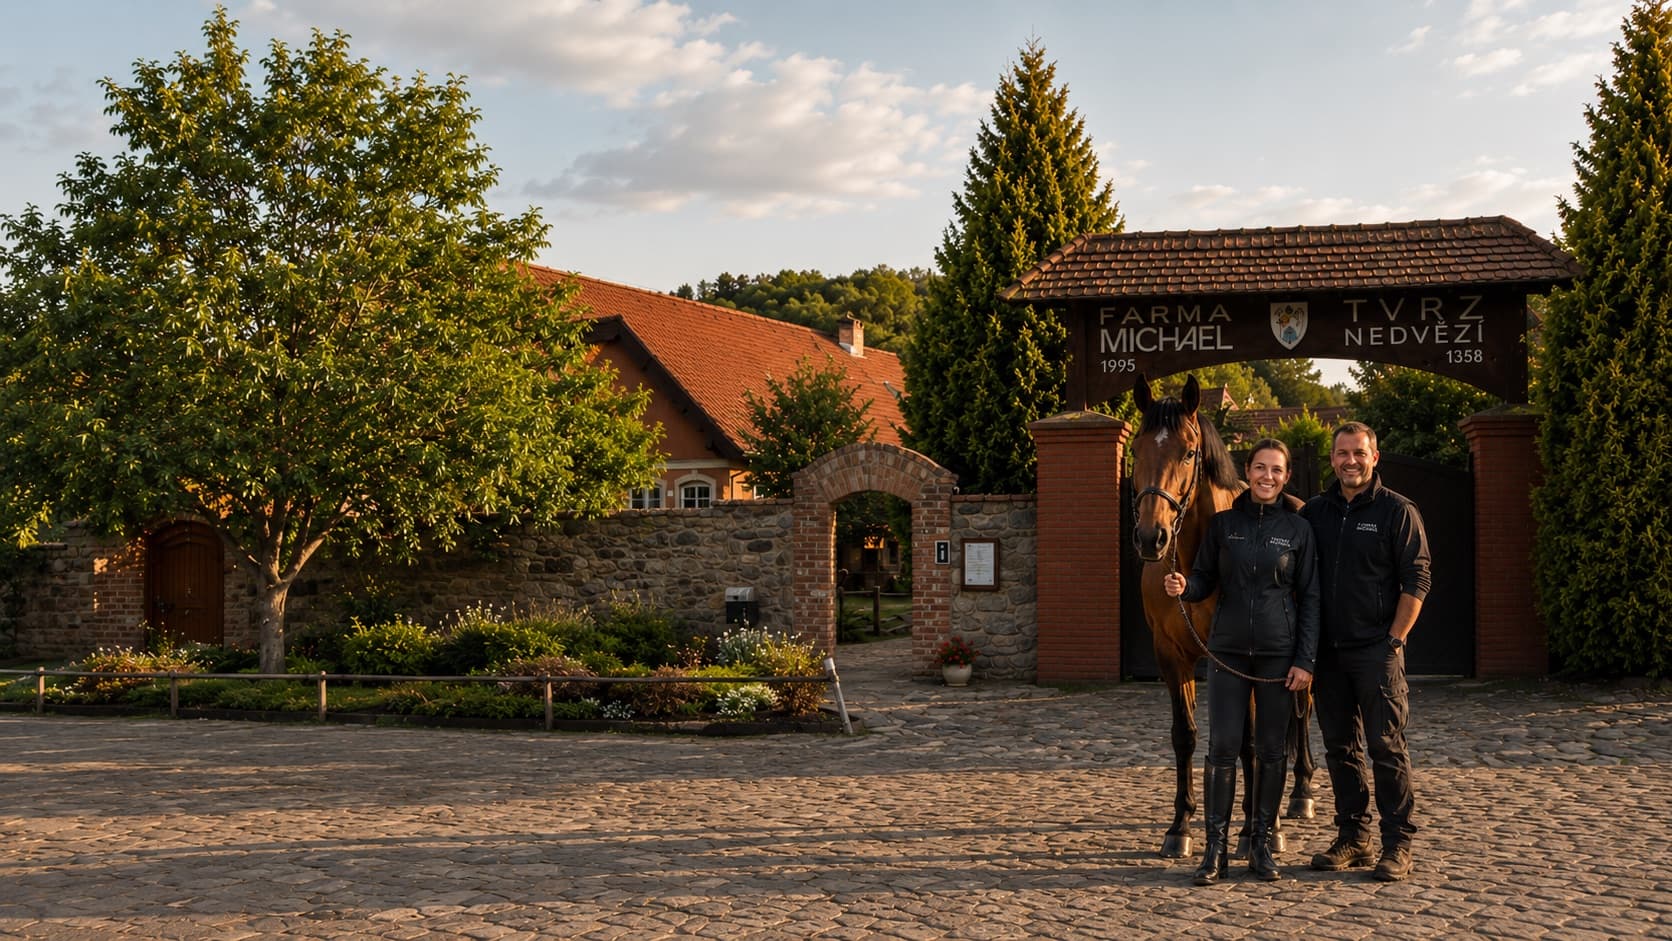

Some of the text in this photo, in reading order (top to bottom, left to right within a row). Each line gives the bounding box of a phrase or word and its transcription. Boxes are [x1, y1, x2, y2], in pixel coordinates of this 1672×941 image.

[1100, 304, 1233, 325] FARMA
[1343, 295, 1484, 323] TVRZ
[1100, 325, 1234, 353] MICHAEL
[1344, 319, 1485, 347] NEDVĚZÍ
[1101, 358, 1136, 373] 1995
[1446, 349, 1483, 364] 1358
